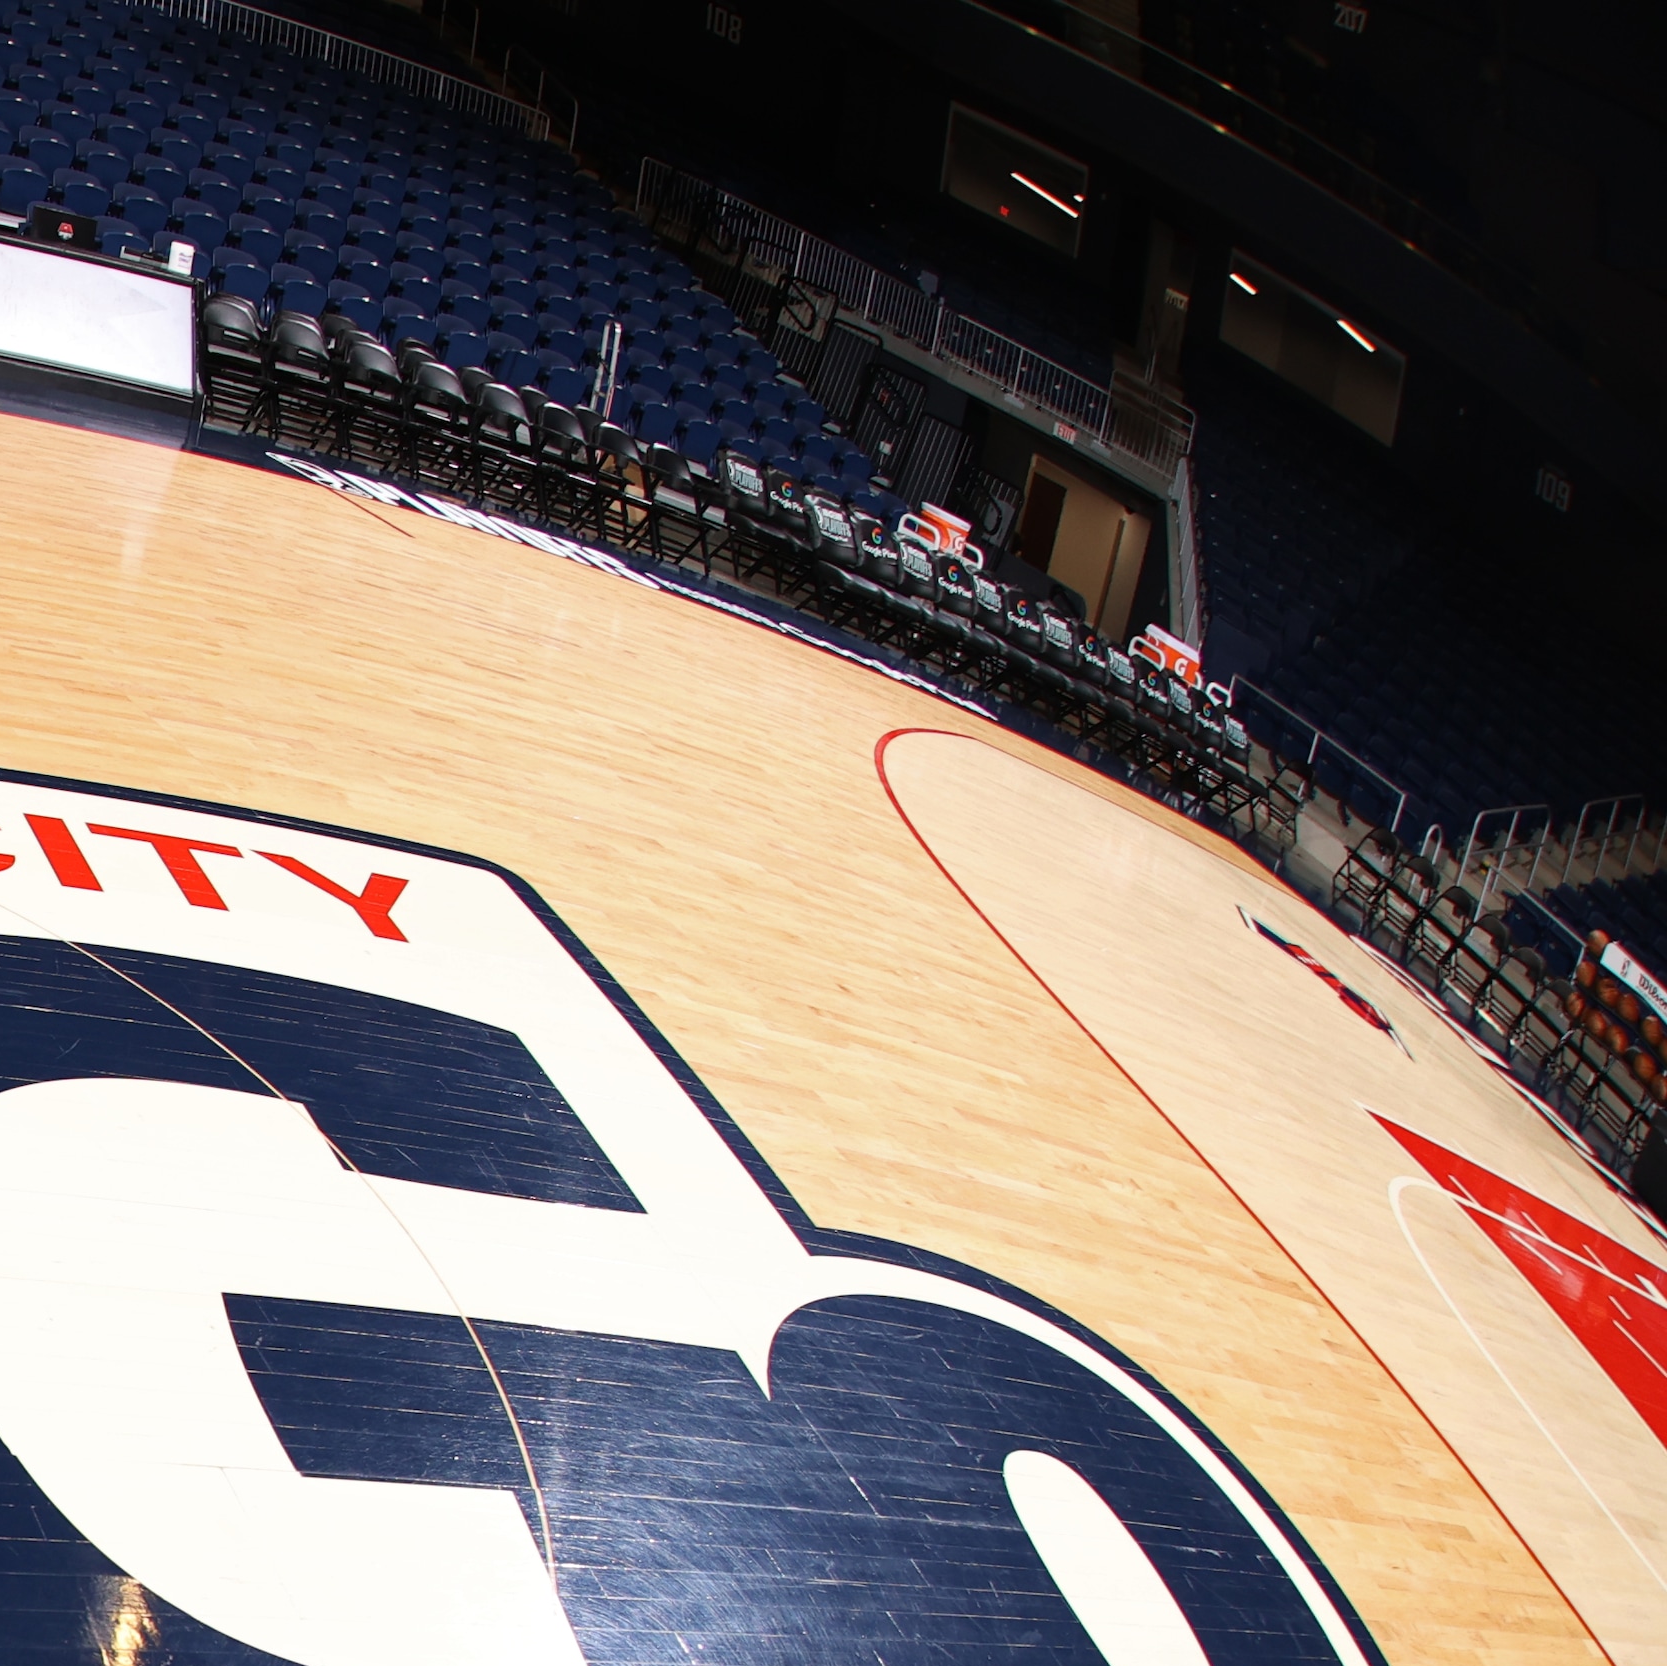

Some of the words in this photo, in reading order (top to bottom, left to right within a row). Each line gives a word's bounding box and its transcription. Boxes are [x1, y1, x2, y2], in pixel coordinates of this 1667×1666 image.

[704, 2, 742, 46] 108
[1334, 2, 1369, 34] 207
[1535, 467, 1574, 512] 109
[954, 536, 965, 551] G
[1174, 657, 1188, 677] G
